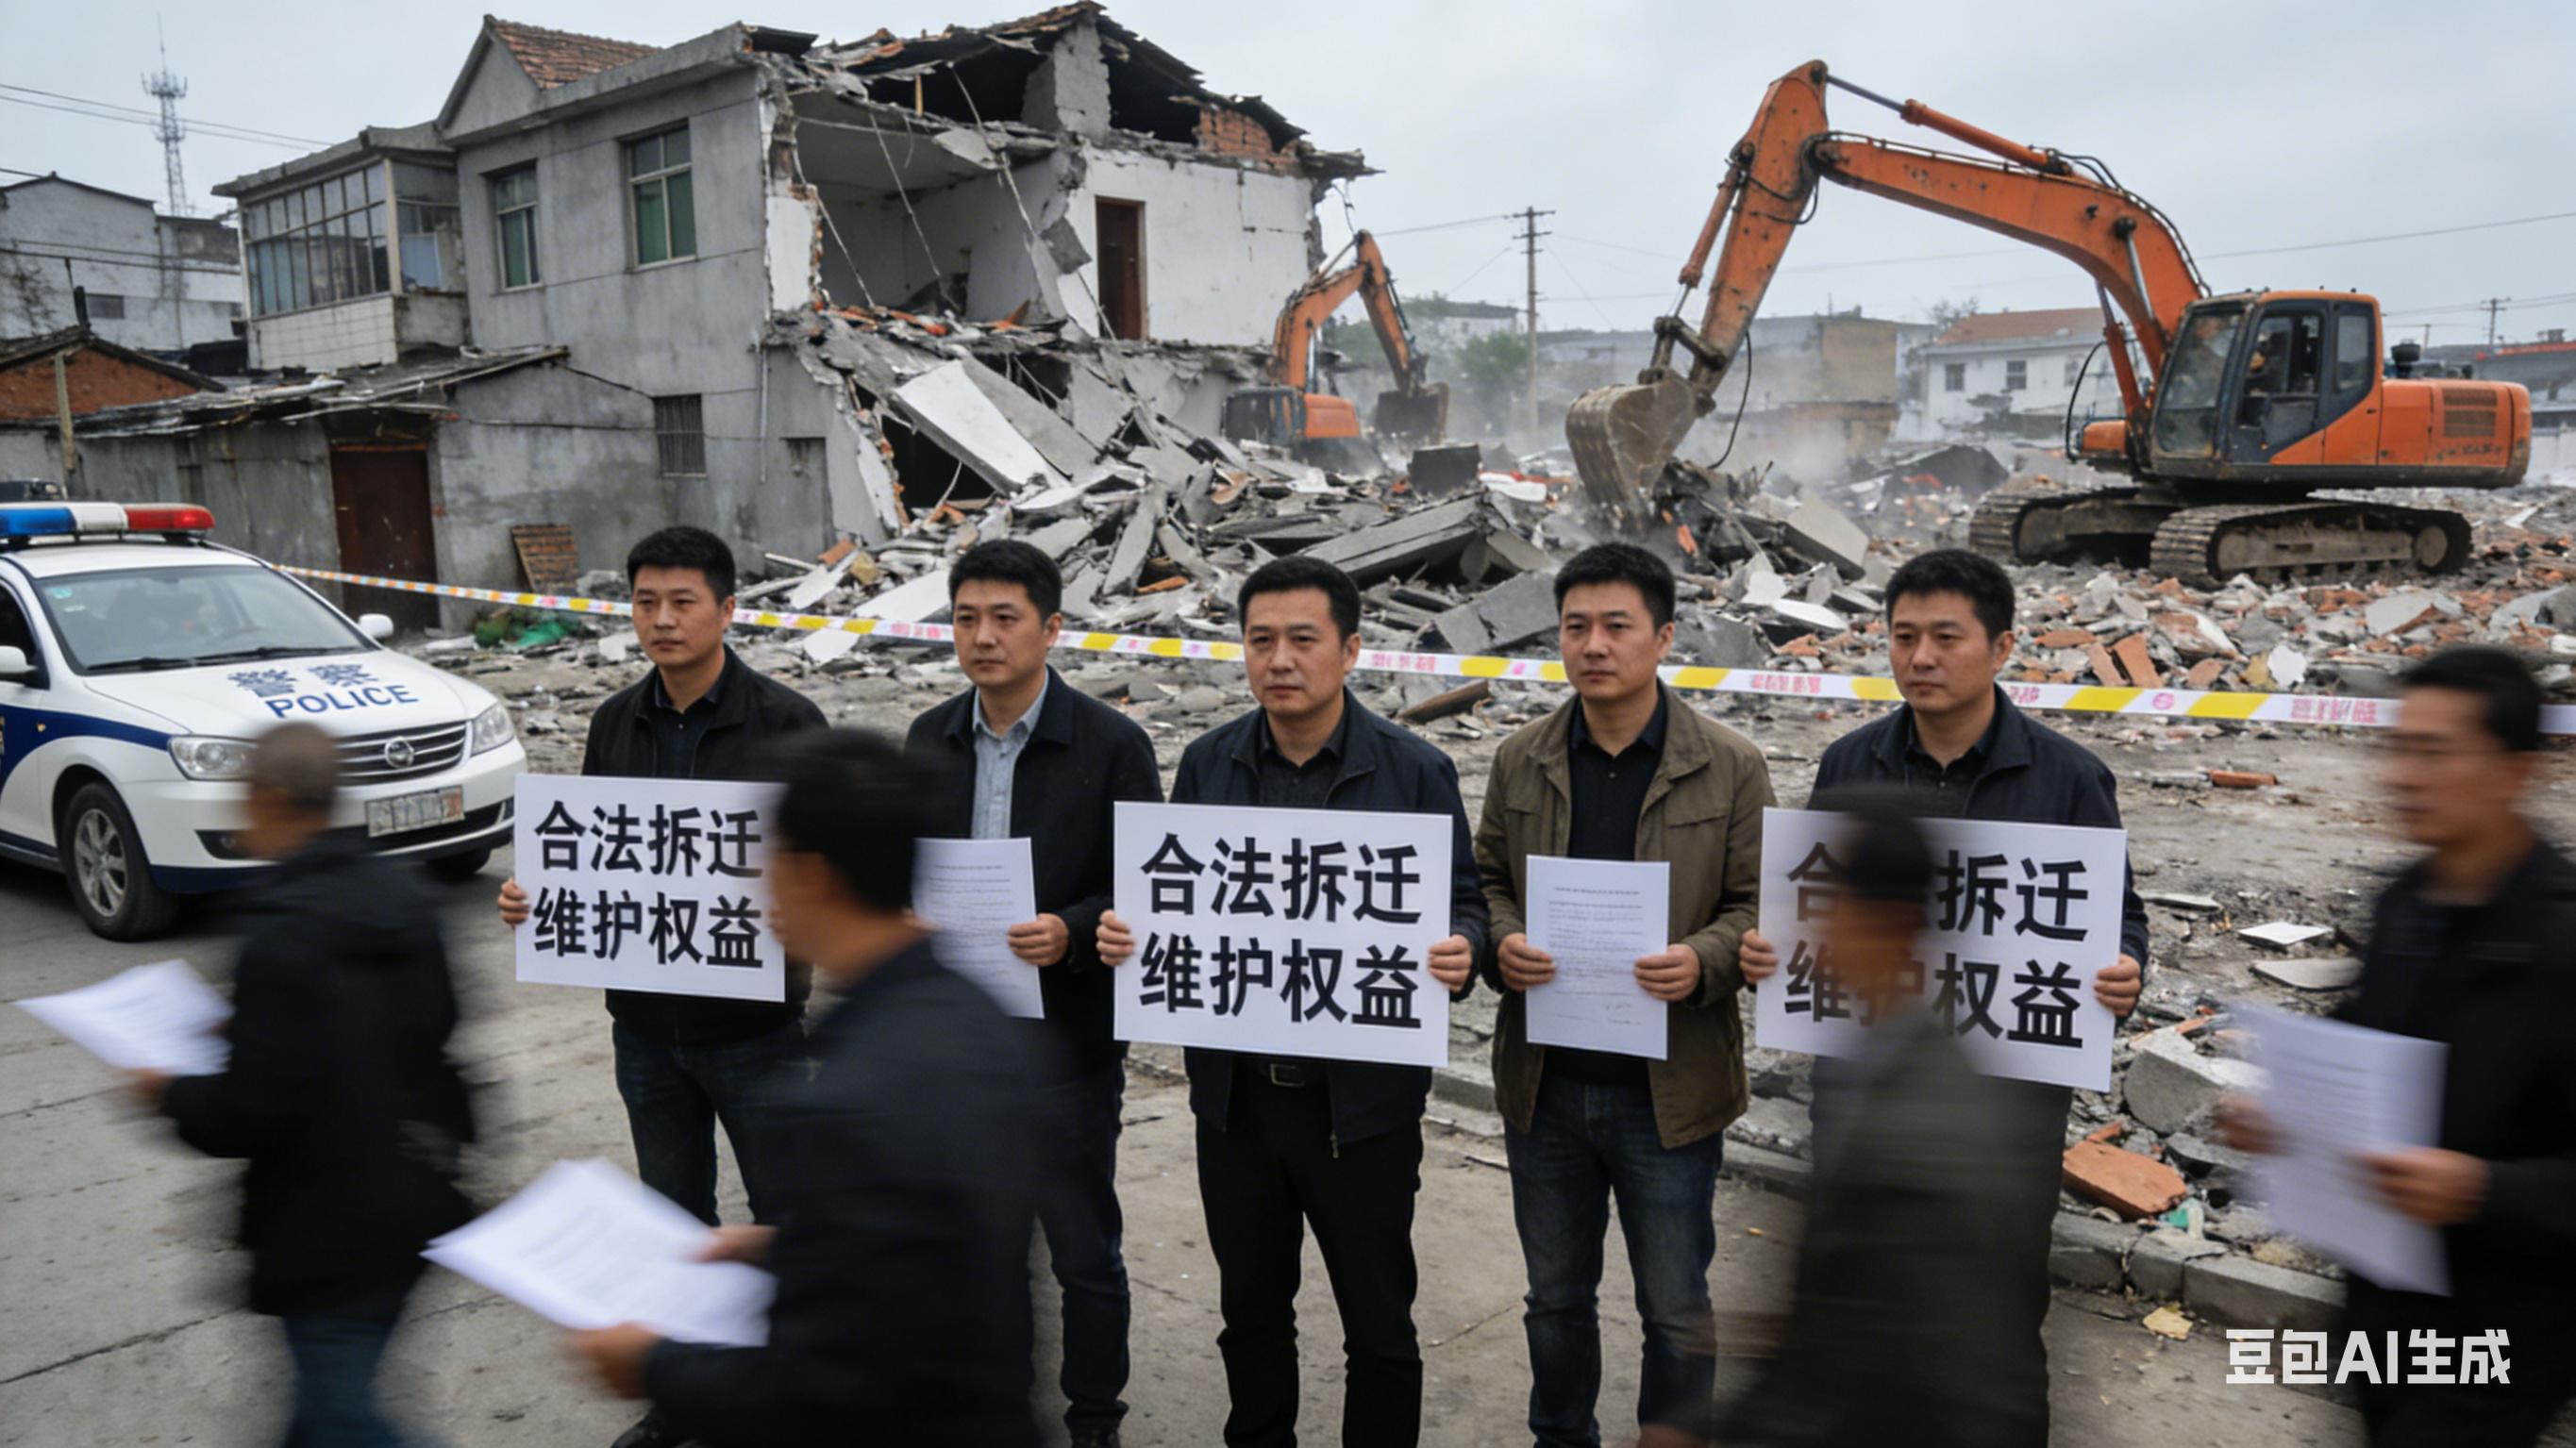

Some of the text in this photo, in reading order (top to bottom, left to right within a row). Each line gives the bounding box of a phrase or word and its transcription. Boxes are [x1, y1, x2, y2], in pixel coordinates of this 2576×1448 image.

[264, 684, 420, 719] POLICE
[533, 800, 762, 878] 合法拆迁
[1140, 832, 1422, 924] 合法拆迁
[532, 886, 763, 968] 维护权益
[1786, 841, 2089, 941] 合拆迁
[1138, 931, 1423, 1029] 维护权益
